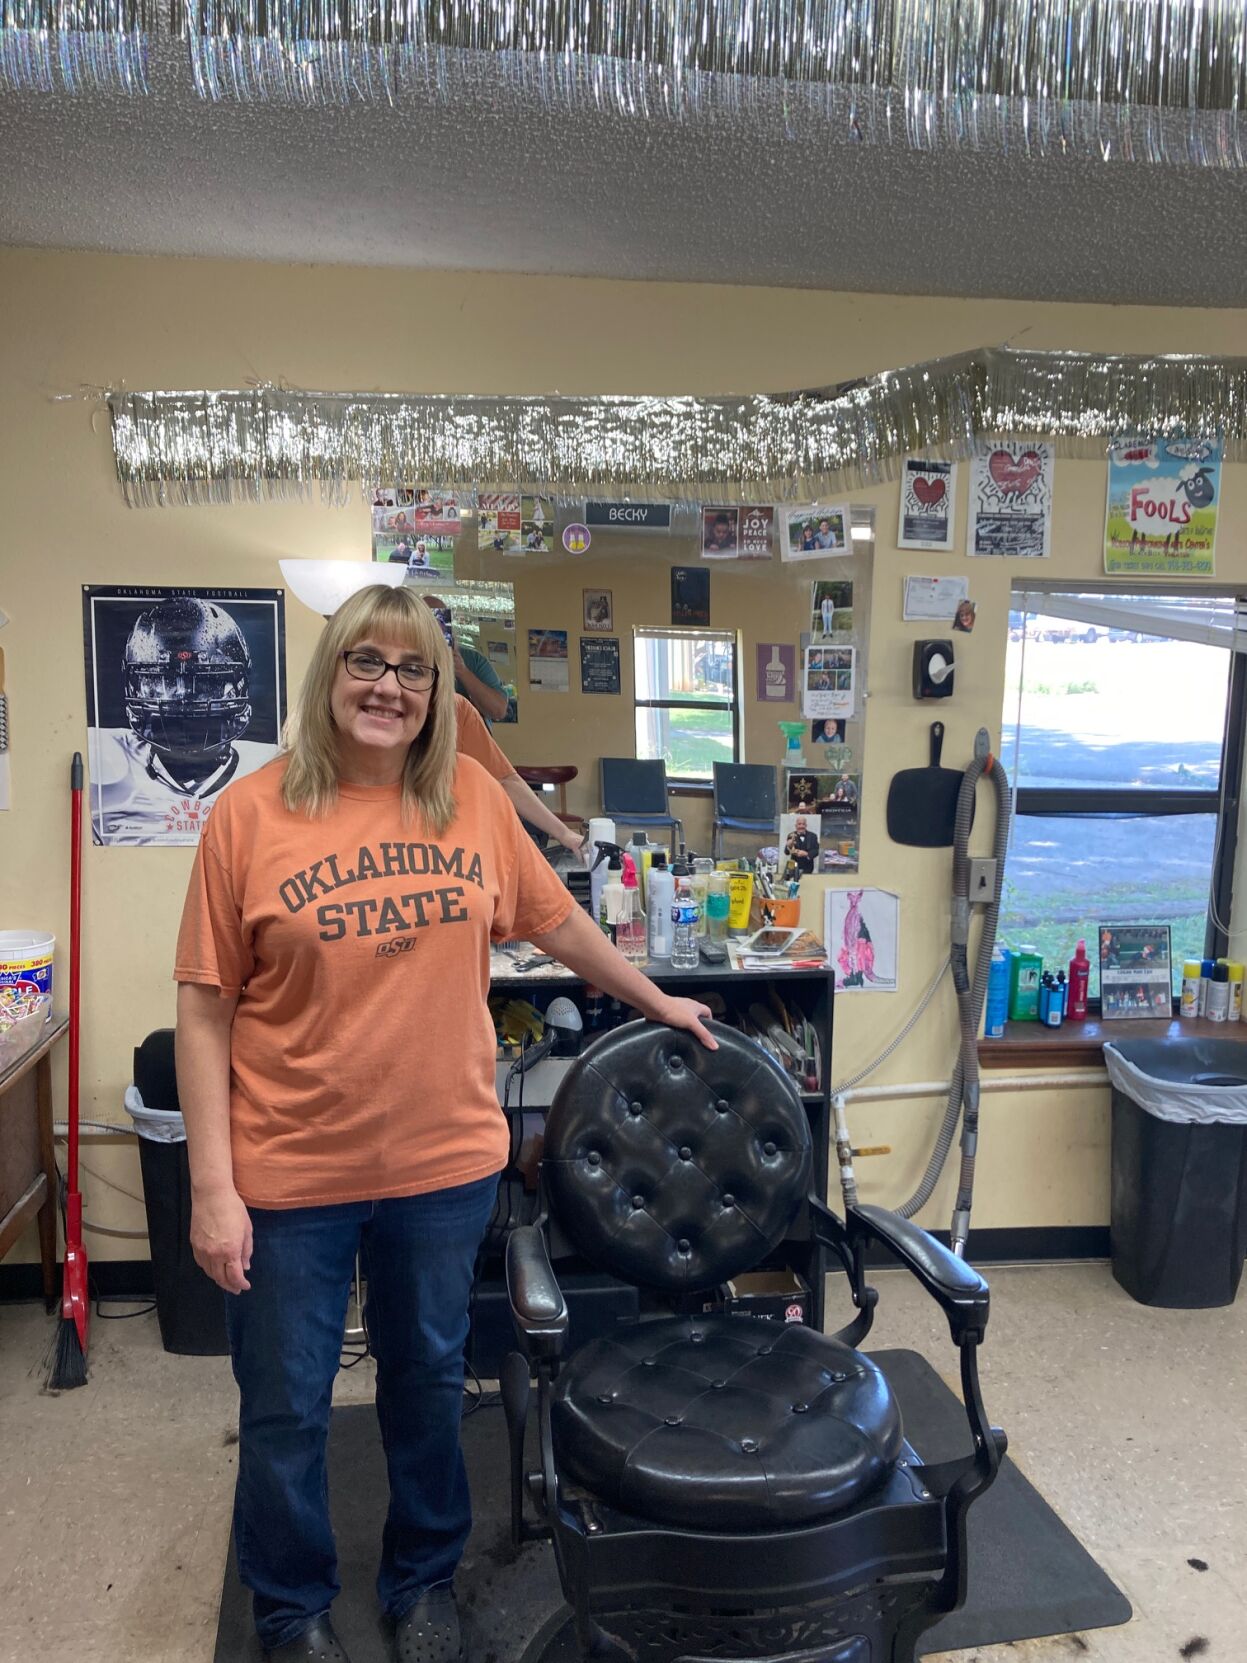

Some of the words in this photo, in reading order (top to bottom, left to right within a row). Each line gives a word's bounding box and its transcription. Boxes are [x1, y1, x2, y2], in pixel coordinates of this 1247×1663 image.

[608, 507, 648, 521] BECKY
[1130, 487, 1191, 524] FOOLS
[742, 518, 769, 529] JOY
[743, 544, 767, 552] LOVE
[117, 588, 162, 596] OKLAHOMA
[171, 589, 196, 597] STATE
[206, 590, 249, 598] FOOTBALL
[165, 800, 212, 822] COWBO
[278, 842, 485, 914] OKLAHOMA
[316, 886, 469, 942] STATE
[375, 936, 418, 958] OSU
